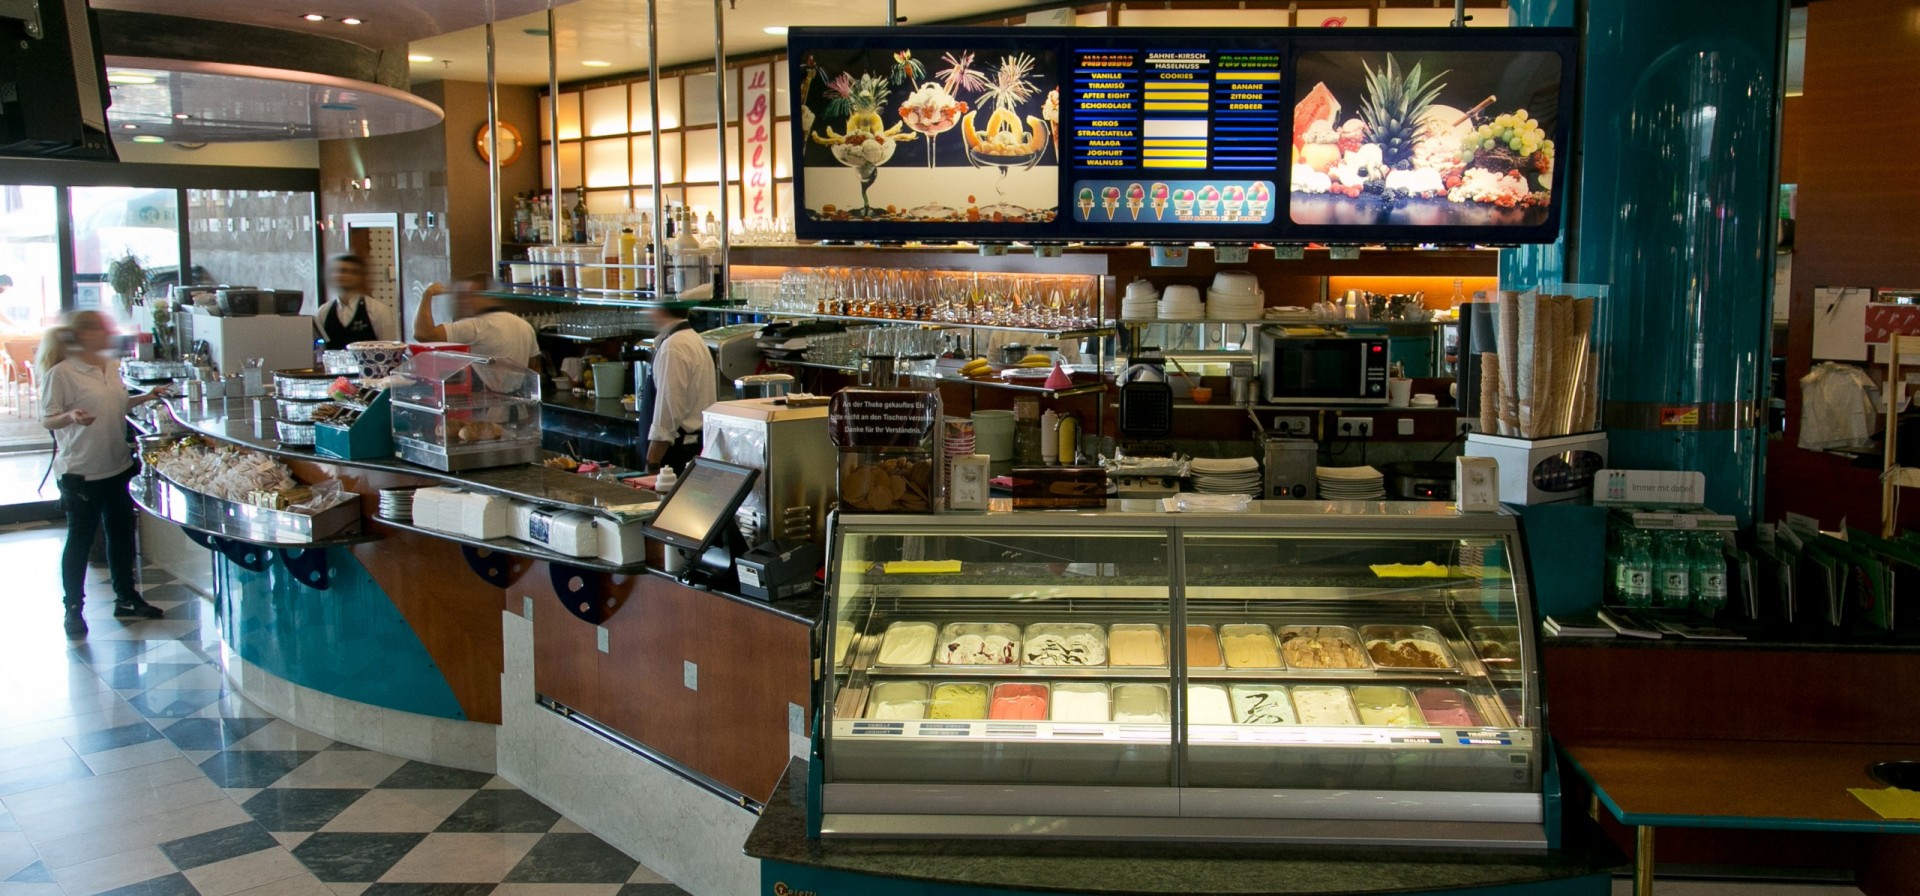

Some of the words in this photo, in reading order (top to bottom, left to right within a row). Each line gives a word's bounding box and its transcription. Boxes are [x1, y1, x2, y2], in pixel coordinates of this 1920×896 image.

[746, 93, 768, 220] Gelat
[884, 401, 914, 410] gekauftes
[915, 401, 925, 409] Eis
[1632, 484, 1655, 492] Immer
[1658, 484, 1669, 492] mit
